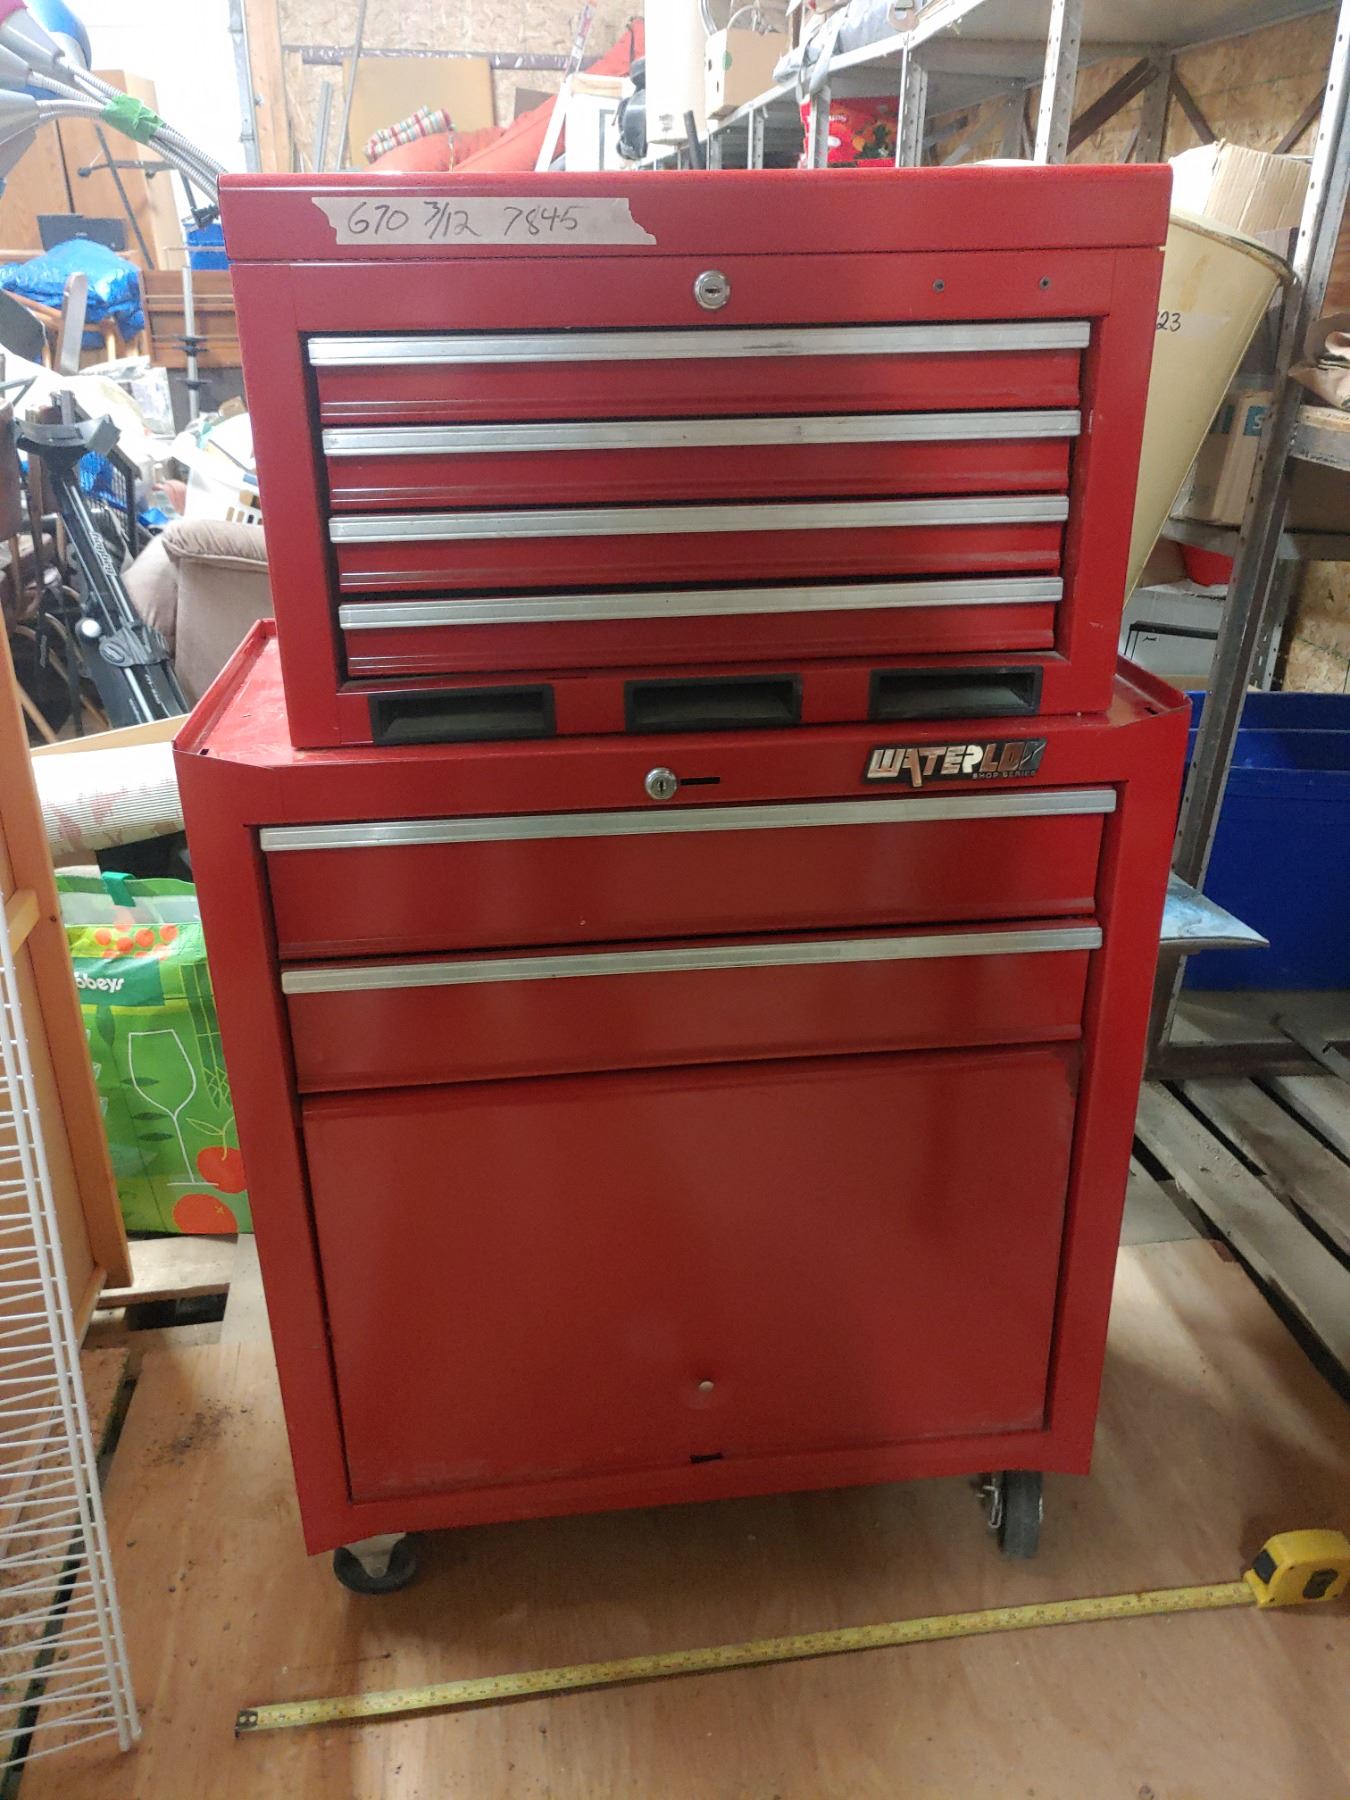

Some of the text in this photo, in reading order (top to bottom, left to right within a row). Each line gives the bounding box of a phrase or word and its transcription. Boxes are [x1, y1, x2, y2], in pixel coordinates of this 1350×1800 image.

[348, 201, 409, 236] 670
[503, 206, 587, 236] 7845
[972, 772, 999, 780] SHOP
